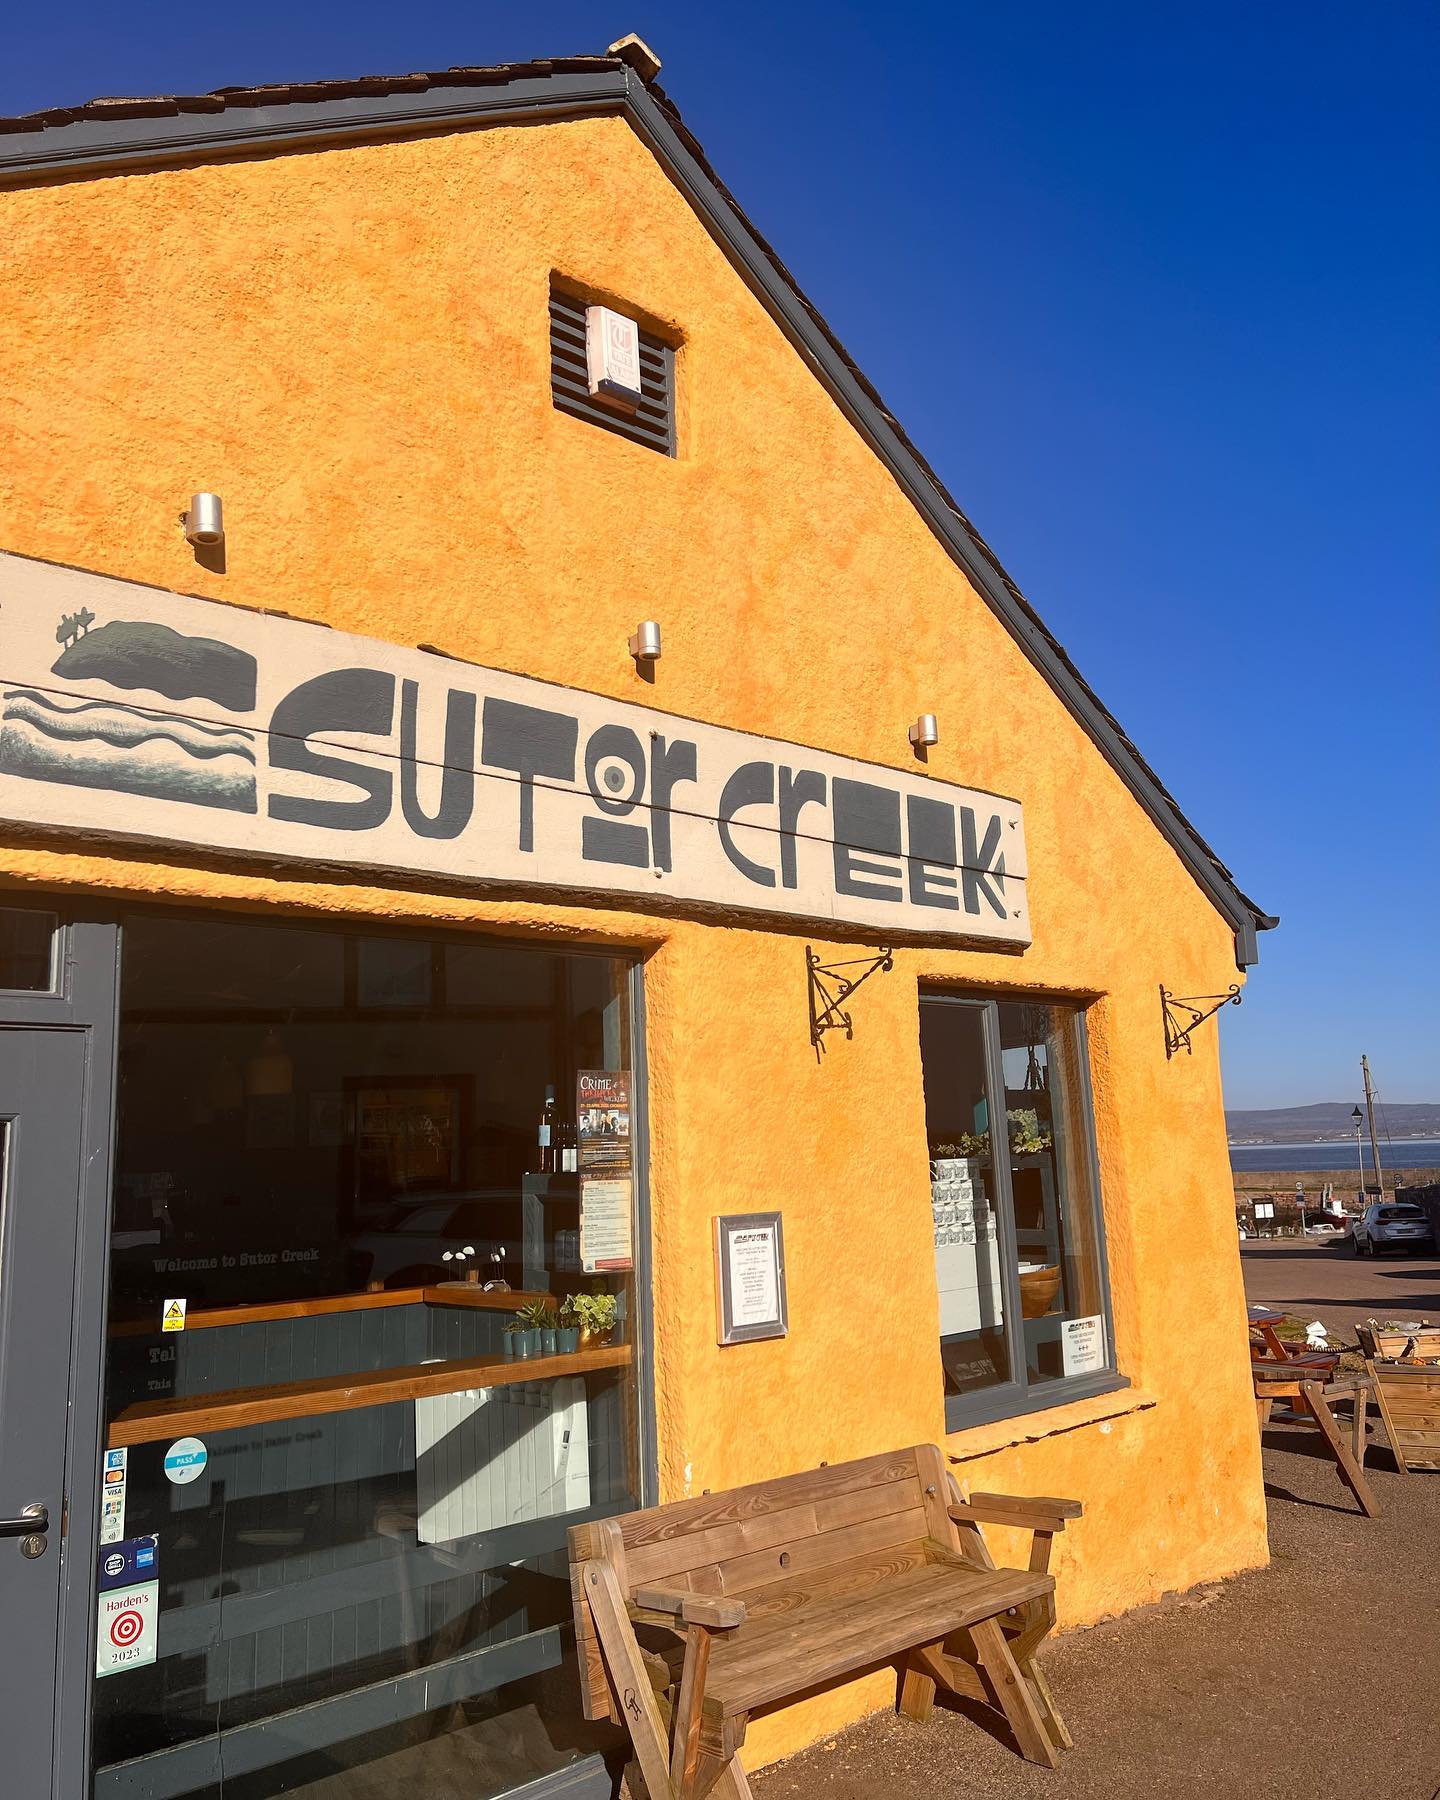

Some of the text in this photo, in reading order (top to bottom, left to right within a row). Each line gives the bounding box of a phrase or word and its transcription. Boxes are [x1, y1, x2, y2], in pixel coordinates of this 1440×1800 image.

[153, 1248, 320, 1273] Welcome to Sutor Creek
[147, 1378, 172, 1392] This
[176, 1455, 194, 1466] PASS
[107, 1488, 122, 1496] VISA
[106, 1594, 149, 1612] Harden's
[111, 1647, 140, 1664] 2023
